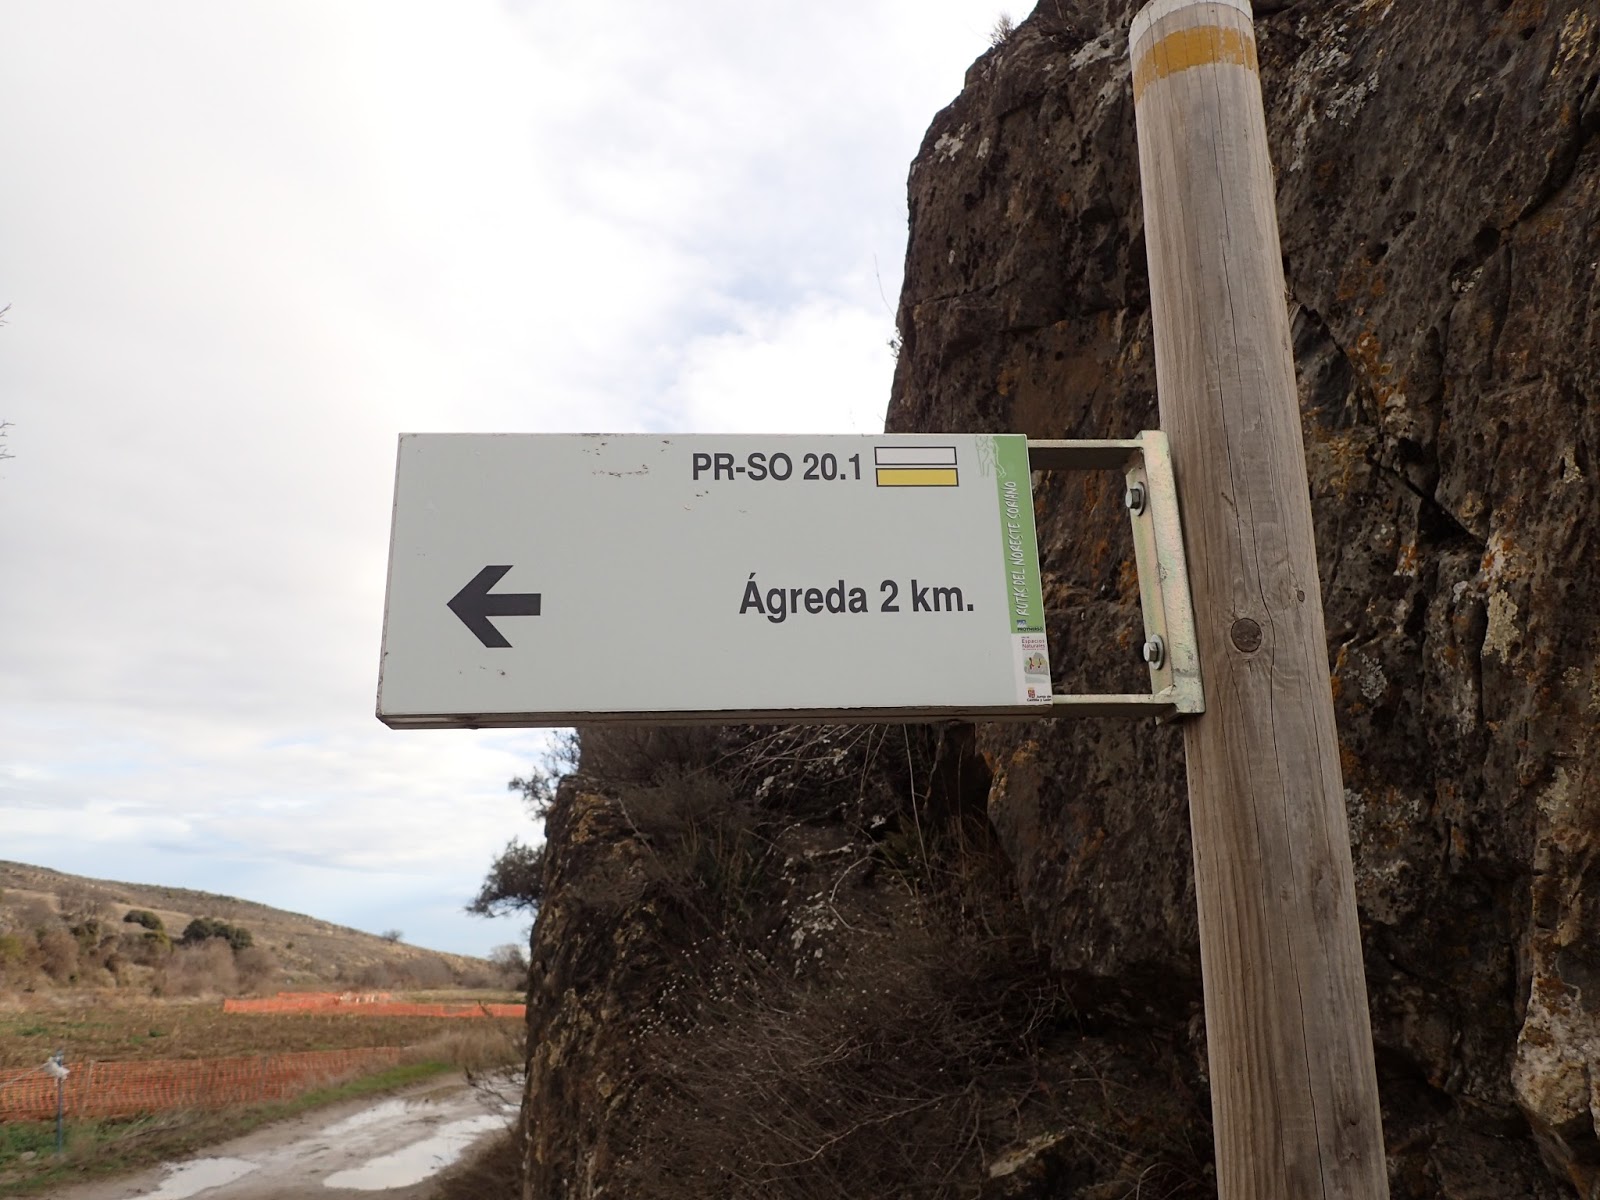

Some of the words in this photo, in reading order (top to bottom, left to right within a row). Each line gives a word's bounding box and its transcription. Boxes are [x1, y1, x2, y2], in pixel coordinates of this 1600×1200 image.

[692, 452, 793, 482] PR-SO
[803, 452, 861, 482] 20.1
[1003, 481, 1021, 519] SORIANO
[1007, 523, 1025, 566] NORESTE
[1012, 568, 1026, 586] DEL
[739, 572, 869, 624] Ágreda
[879, 579, 900, 613] 2
[910, 579, 975, 613] km.
[1013, 587, 1030, 617] RUTAS
